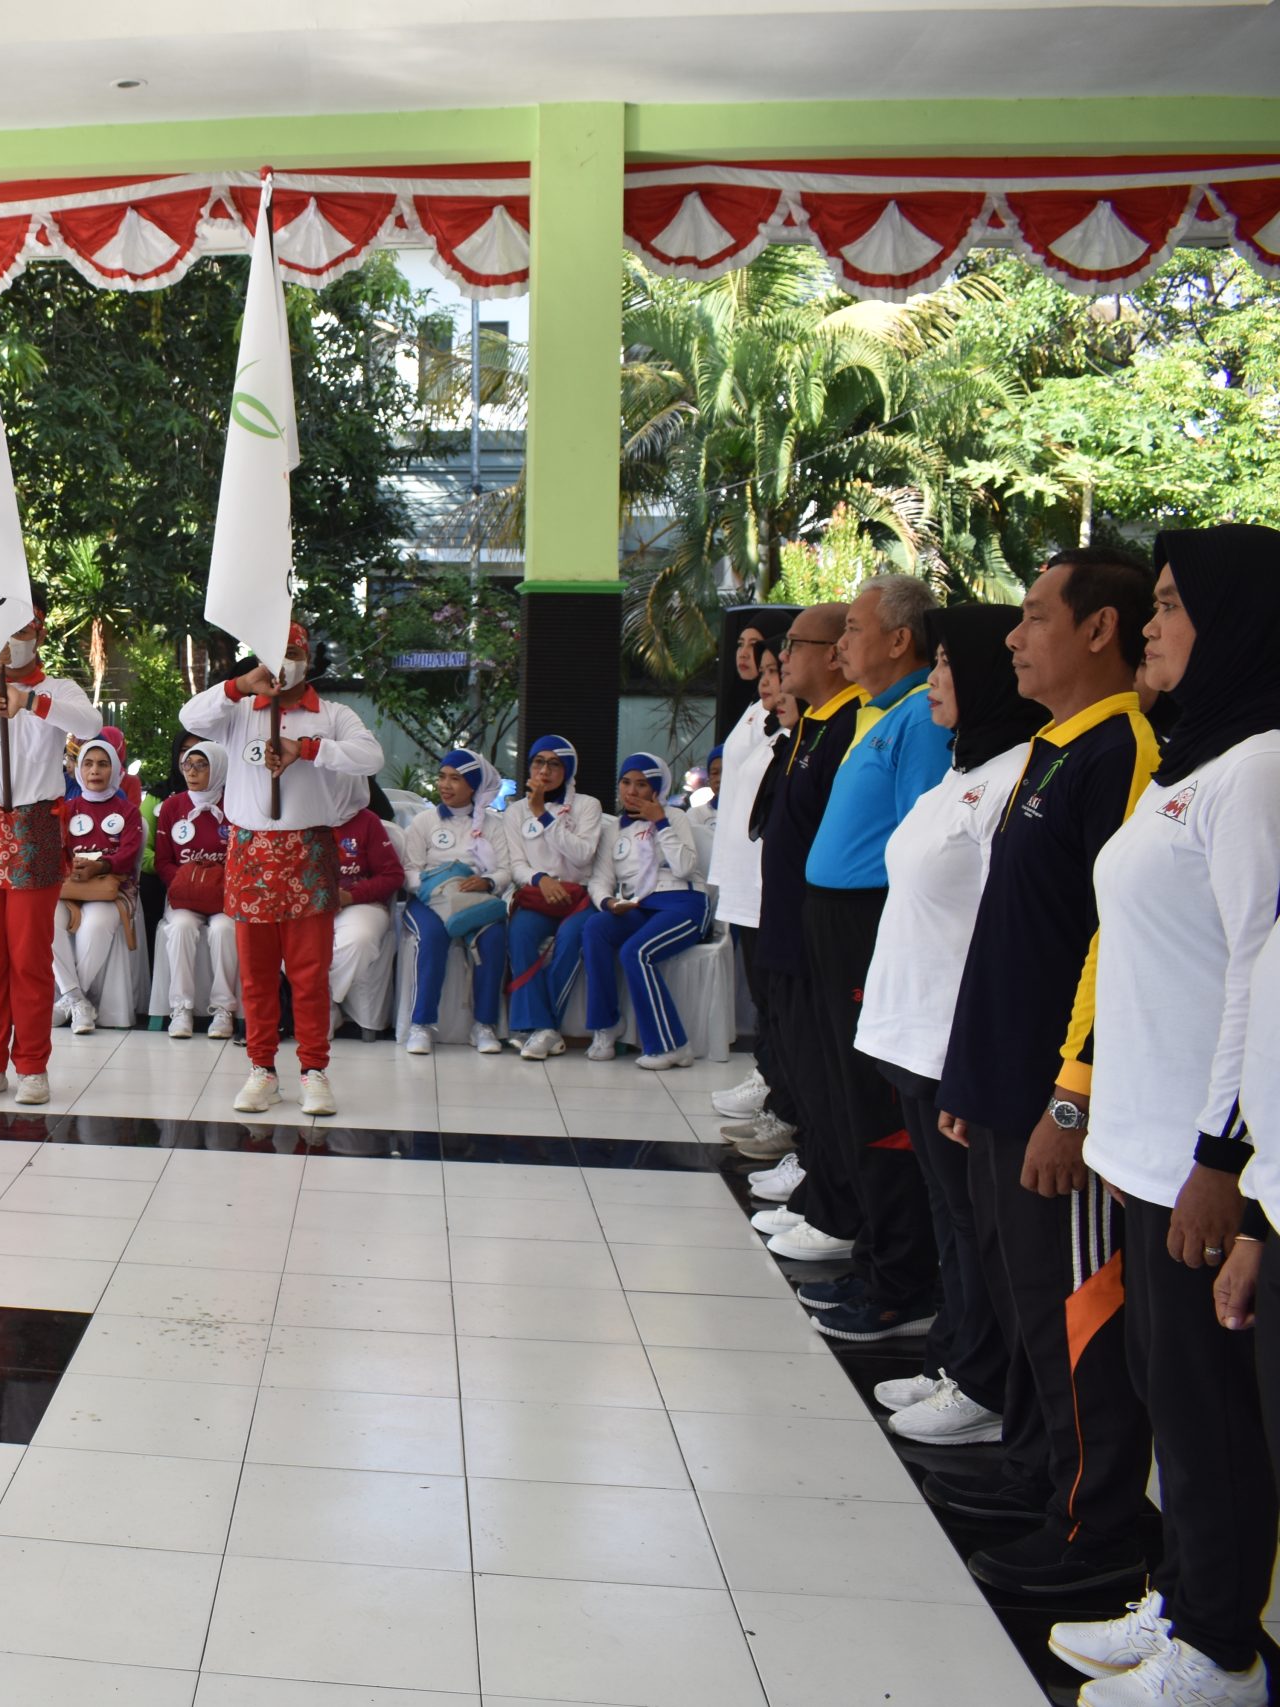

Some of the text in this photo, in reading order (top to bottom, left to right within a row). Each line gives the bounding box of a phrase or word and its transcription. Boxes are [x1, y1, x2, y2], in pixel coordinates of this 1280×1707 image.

[250, 747, 262, 761] 3
[77, 820, 84, 832] 1
[179, 825, 187, 839] 3
[438, 833, 449, 844] 2
